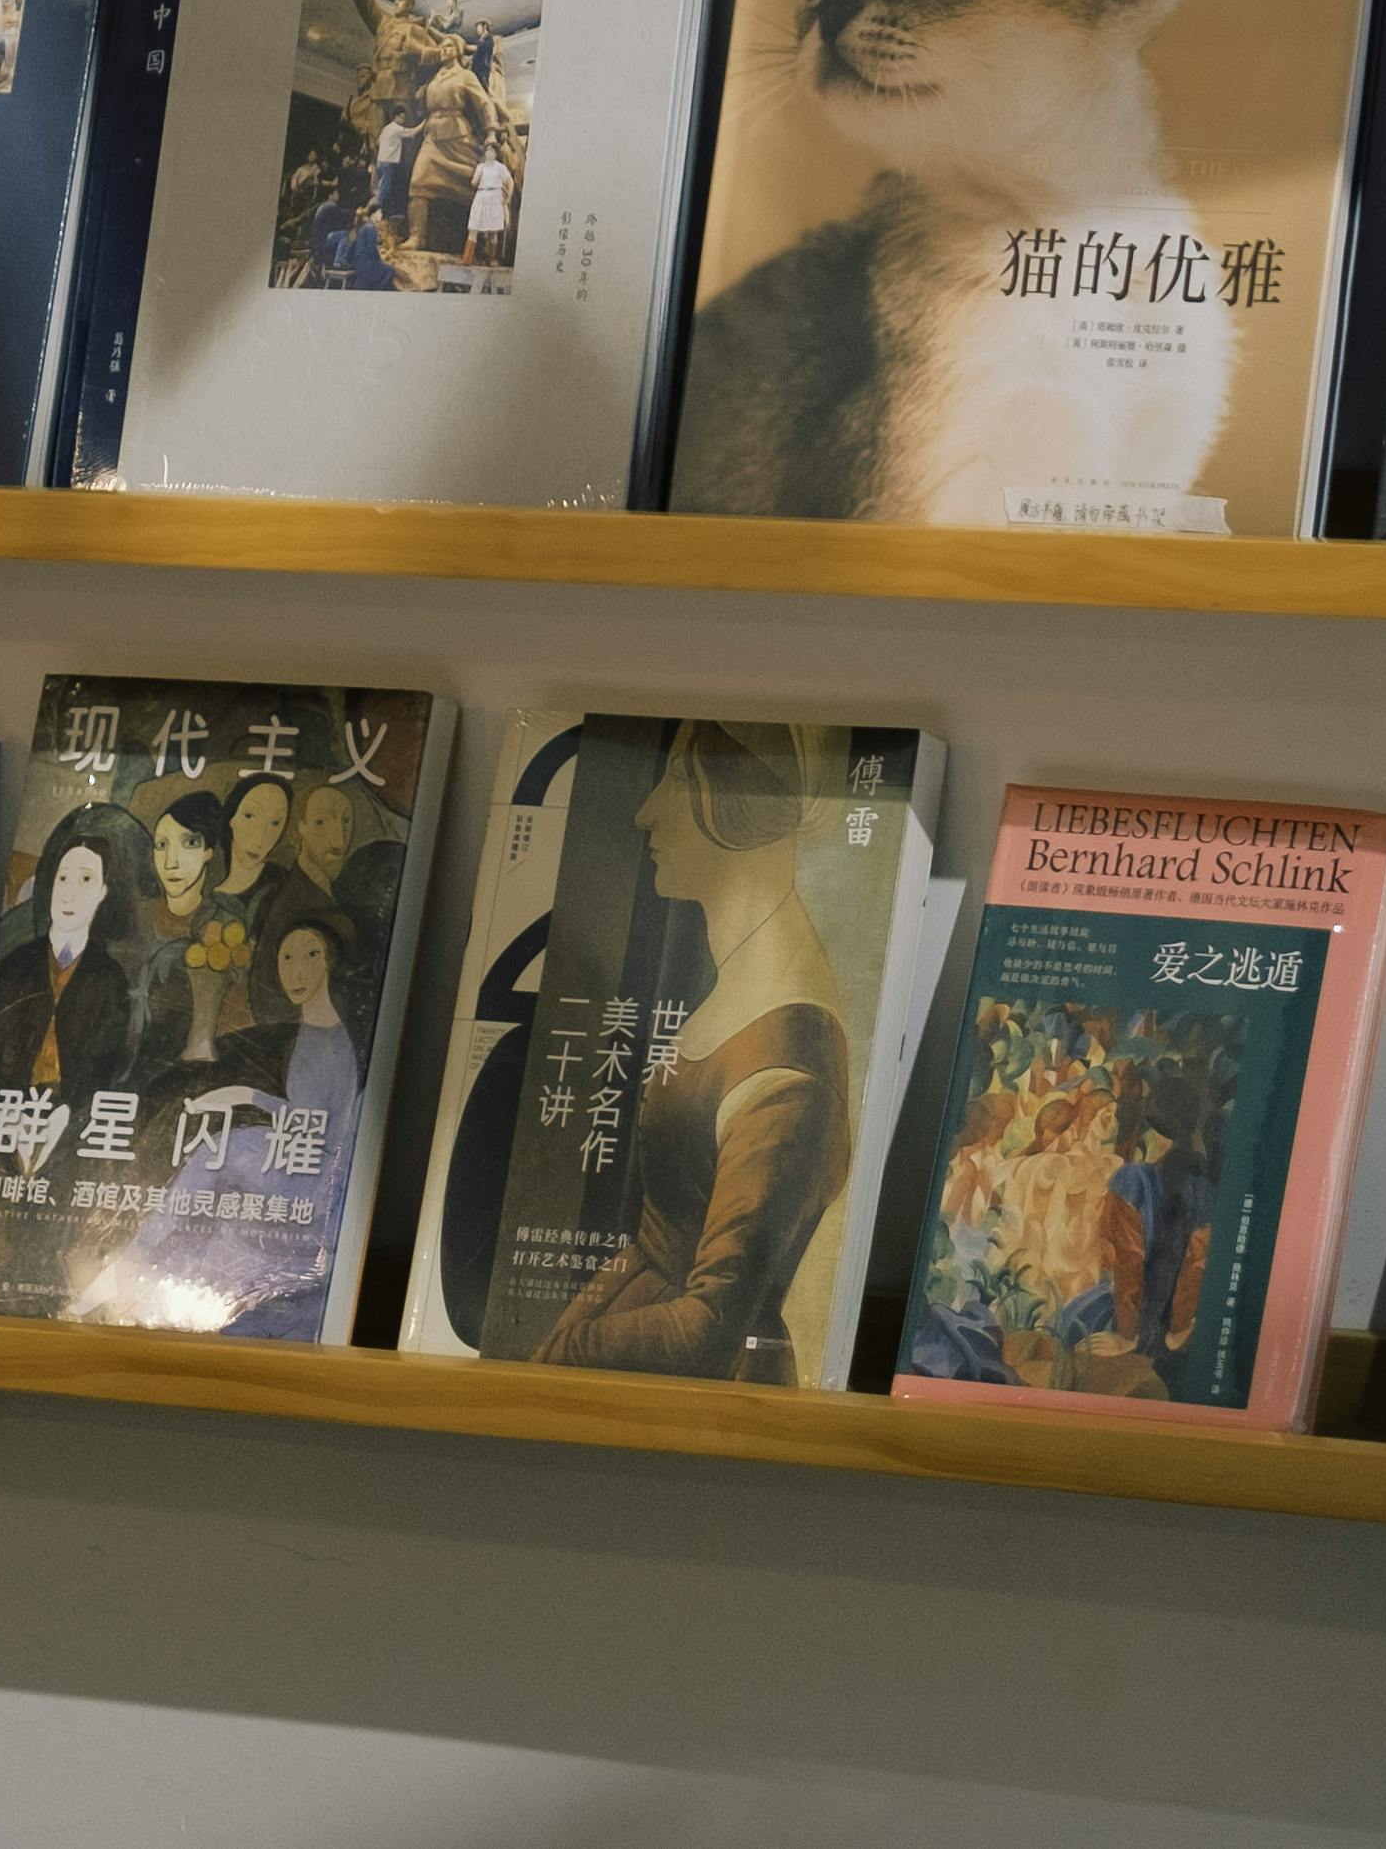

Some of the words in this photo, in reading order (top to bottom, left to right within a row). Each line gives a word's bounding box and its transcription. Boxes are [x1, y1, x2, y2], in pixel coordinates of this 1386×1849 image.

[999, 227, 1286, 308] 猫的优雅
[58, 704, 388, 787] 现代主义
[844, 756, 885, 848] 傅雷
[1033, 803, 1361, 854] LIEBESFLUCHTEN
[1026, 839, 1199, 883] Bernhard
[1211, 850, 1354, 894] Schlink
[1150, 941, 1304, 992] 爱之逃遁
[538, 997, 592, 1129] 二十讲
[642, 999, 689, 1087] 世界
[578, 996, 641, 1174] 美术名作
